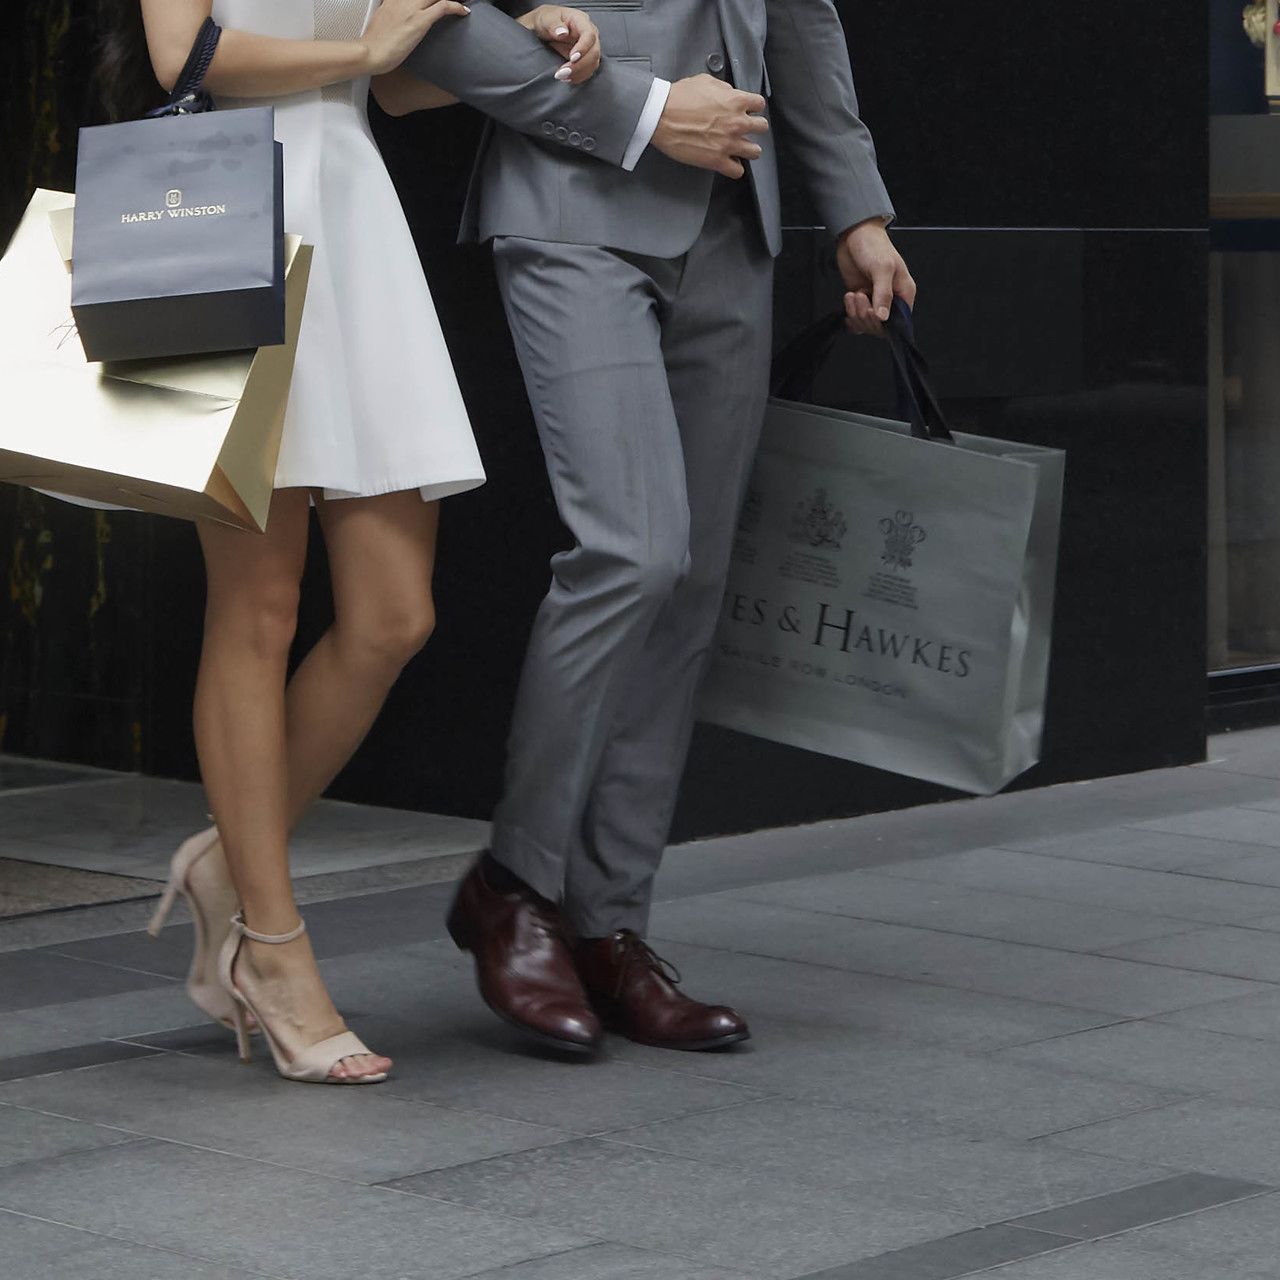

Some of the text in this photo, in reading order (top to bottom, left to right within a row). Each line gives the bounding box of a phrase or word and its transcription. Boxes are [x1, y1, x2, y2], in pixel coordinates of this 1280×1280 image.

[121, 204, 226, 223] HARRY WINSTON
[777, 604, 801, 635] &
[814, 602, 972, 679] HAWKES
